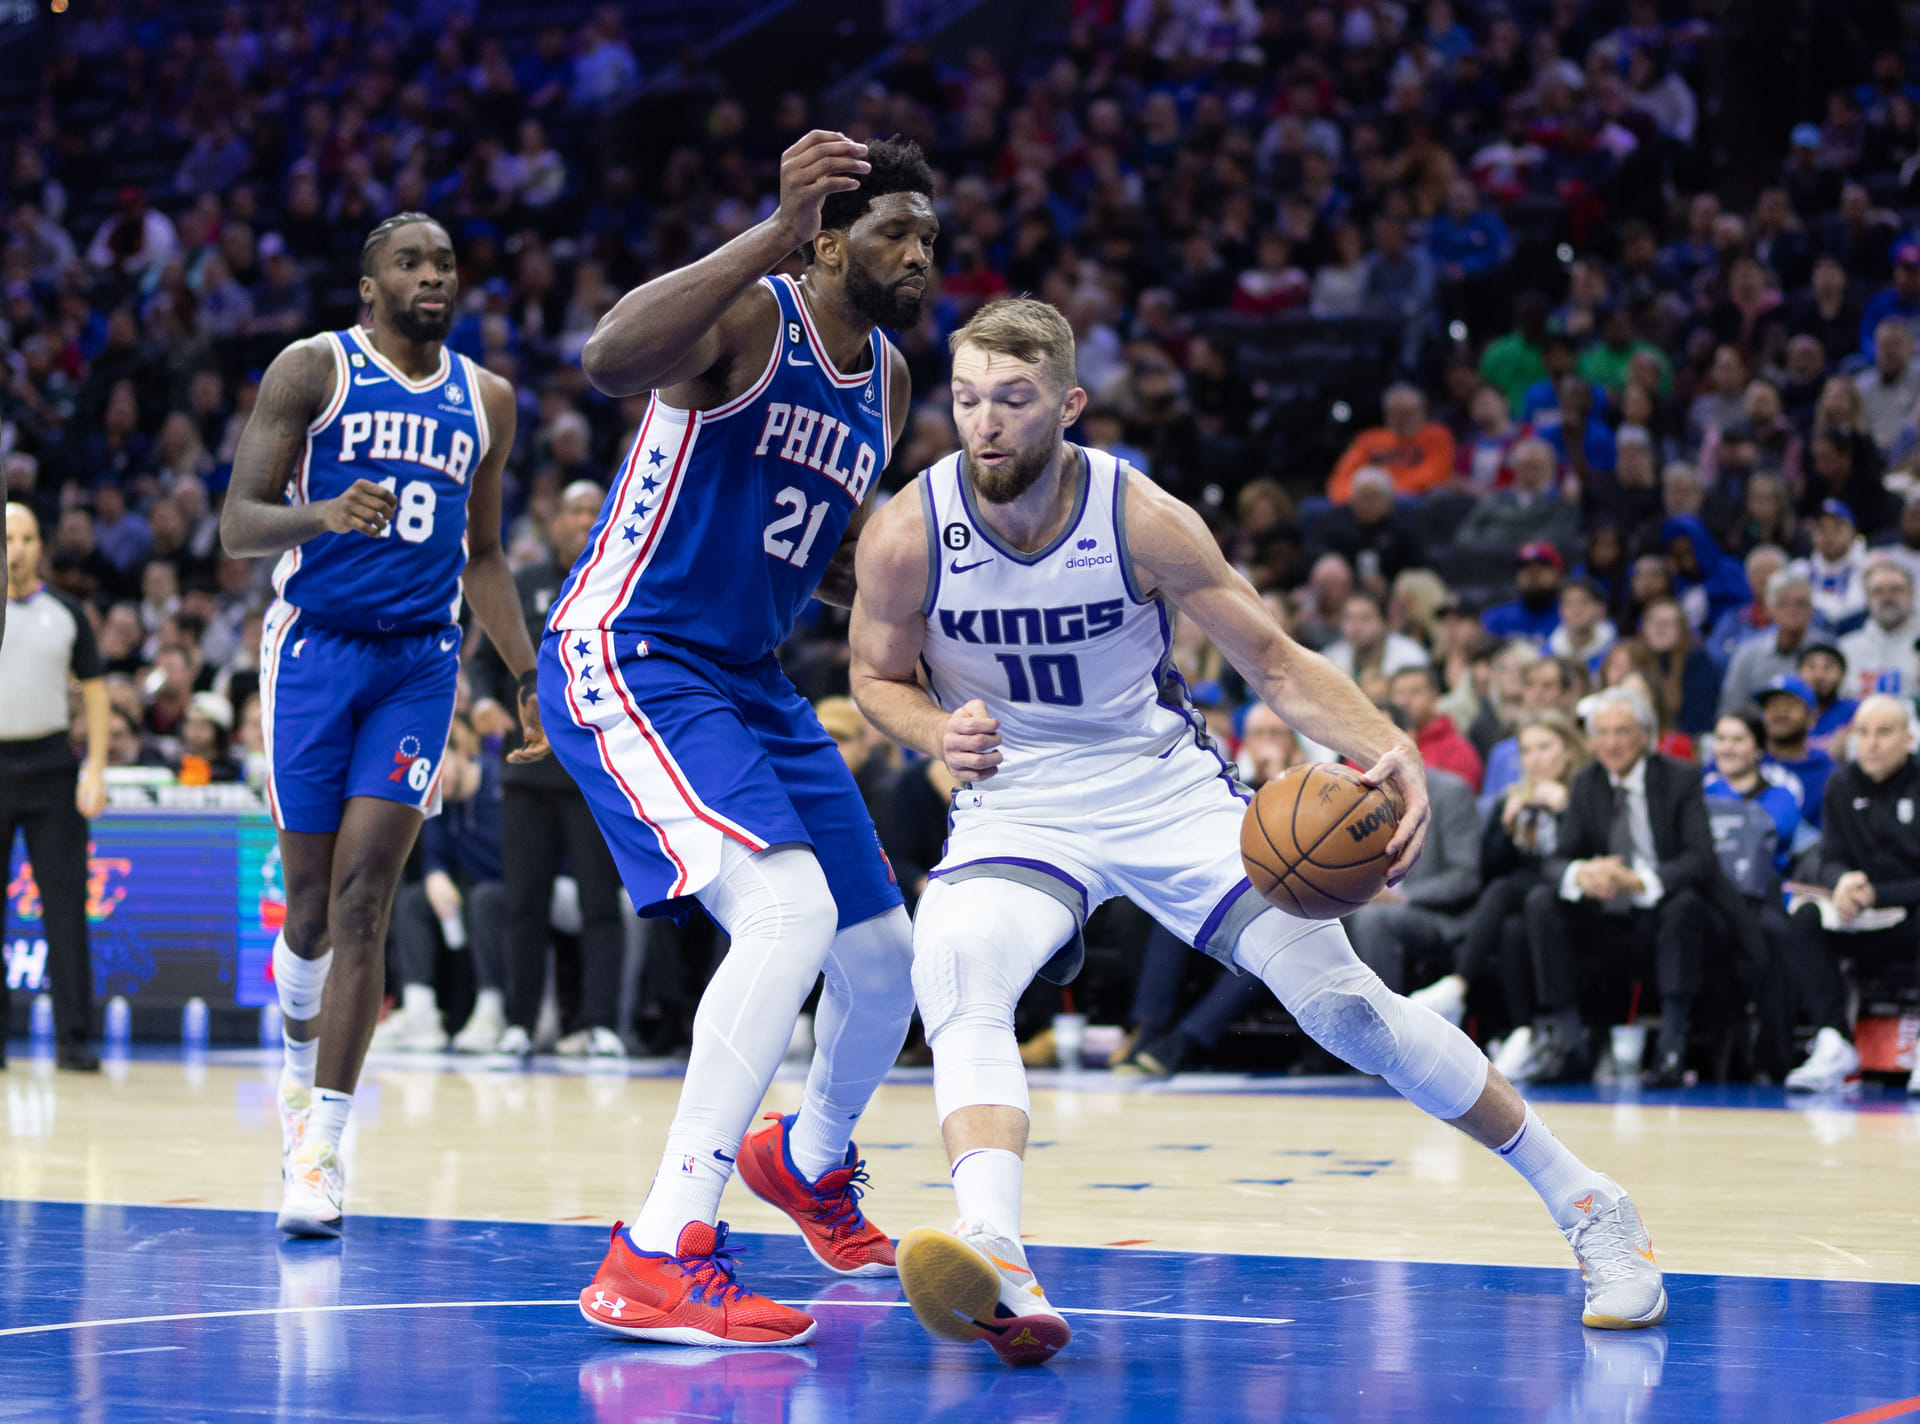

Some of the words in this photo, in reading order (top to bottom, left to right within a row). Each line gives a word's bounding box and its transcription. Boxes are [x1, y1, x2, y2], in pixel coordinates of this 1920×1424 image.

[789, 323, 801, 343] 6
[351, 353, 365, 367] 6
[338, 410, 474, 486] PHILA
[753, 402, 876, 507] PHILA
[763, 486, 830, 568] 21
[949, 526, 966, 548] 6
[1065, 553, 1112, 569] dialpad
[938, 597, 1125, 646] KINGS
[994, 653, 1084, 707] 10
[388, 750, 431, 791] 76
